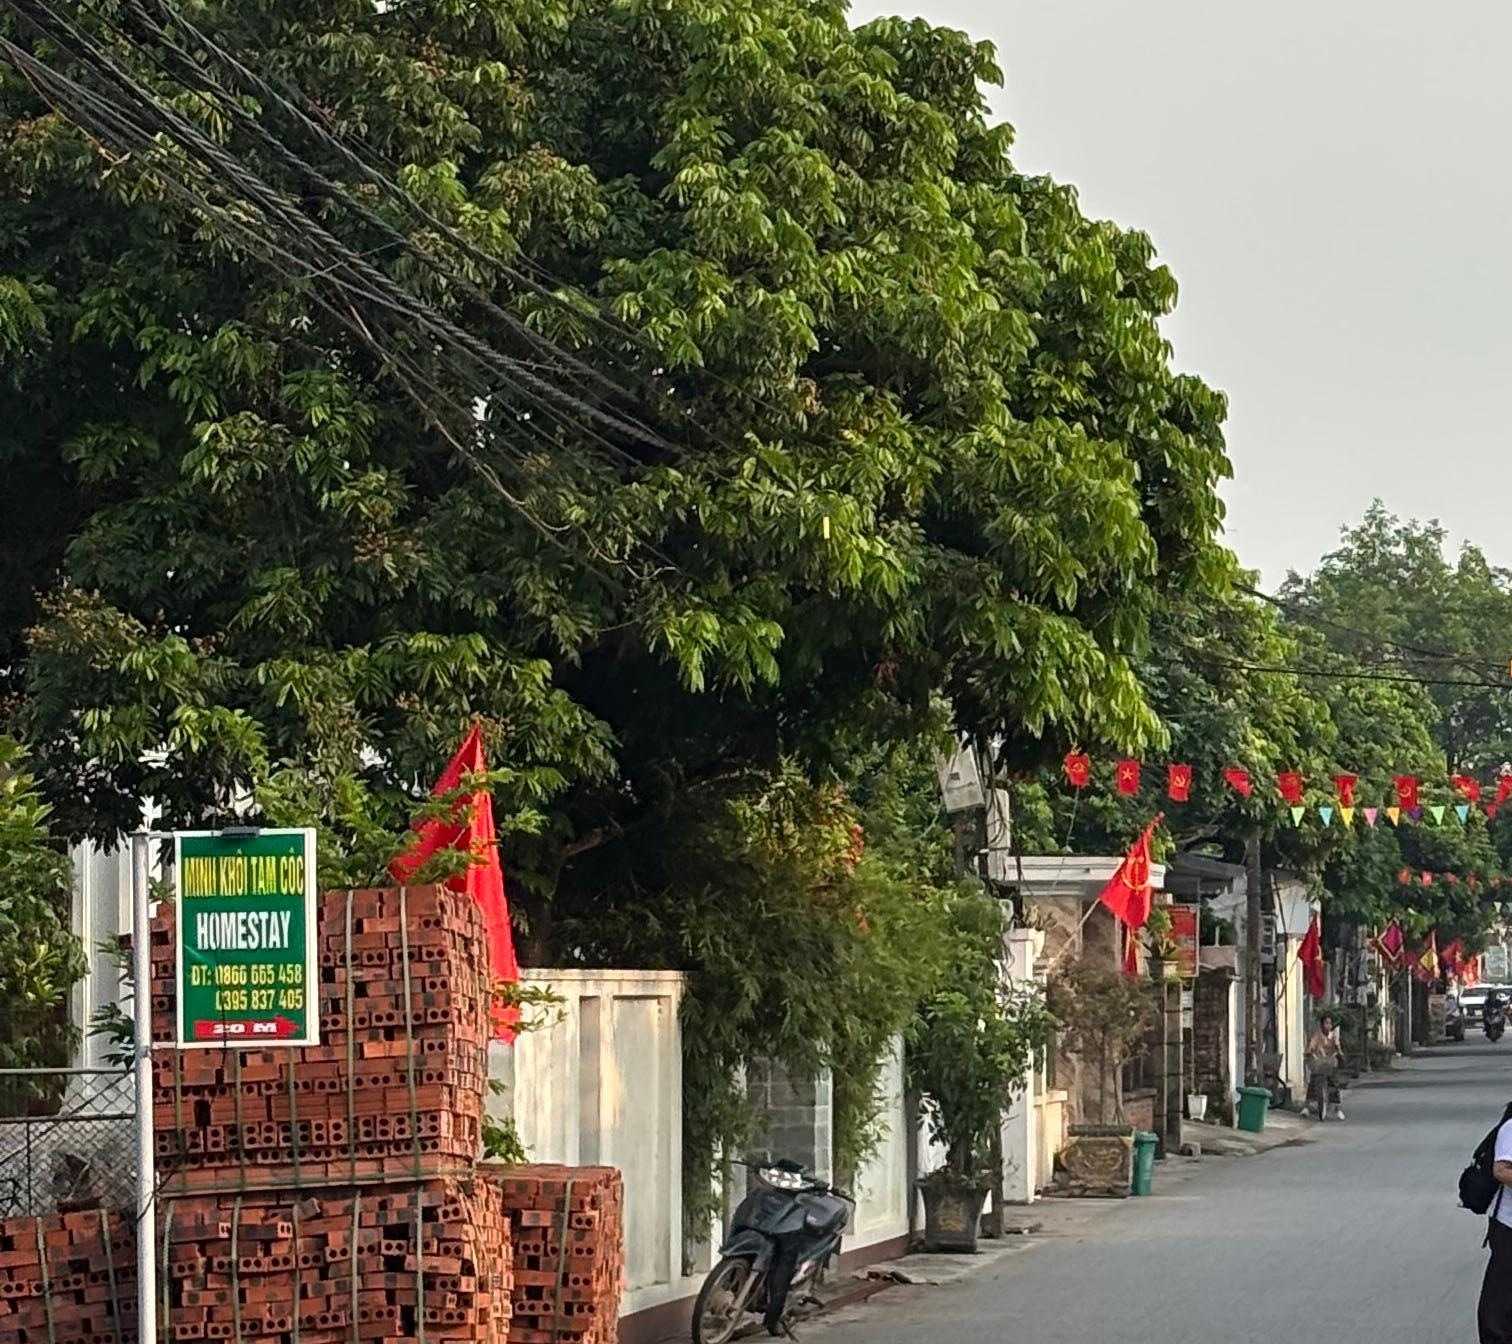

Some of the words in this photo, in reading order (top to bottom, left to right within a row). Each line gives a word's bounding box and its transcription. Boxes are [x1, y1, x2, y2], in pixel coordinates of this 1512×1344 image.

[184, 856, 216, 897] MINH
[251, 855, 277, 896] TAM
[196, 910, 291, 951] HOMESTAY
[215, 964, 247, 986] 0866
[251, 964, 275, 985] 665
[278, 963, 303, 984] 458
[251, 989, 275, 1010] 837
[278, 988, 303, 1010] 405
